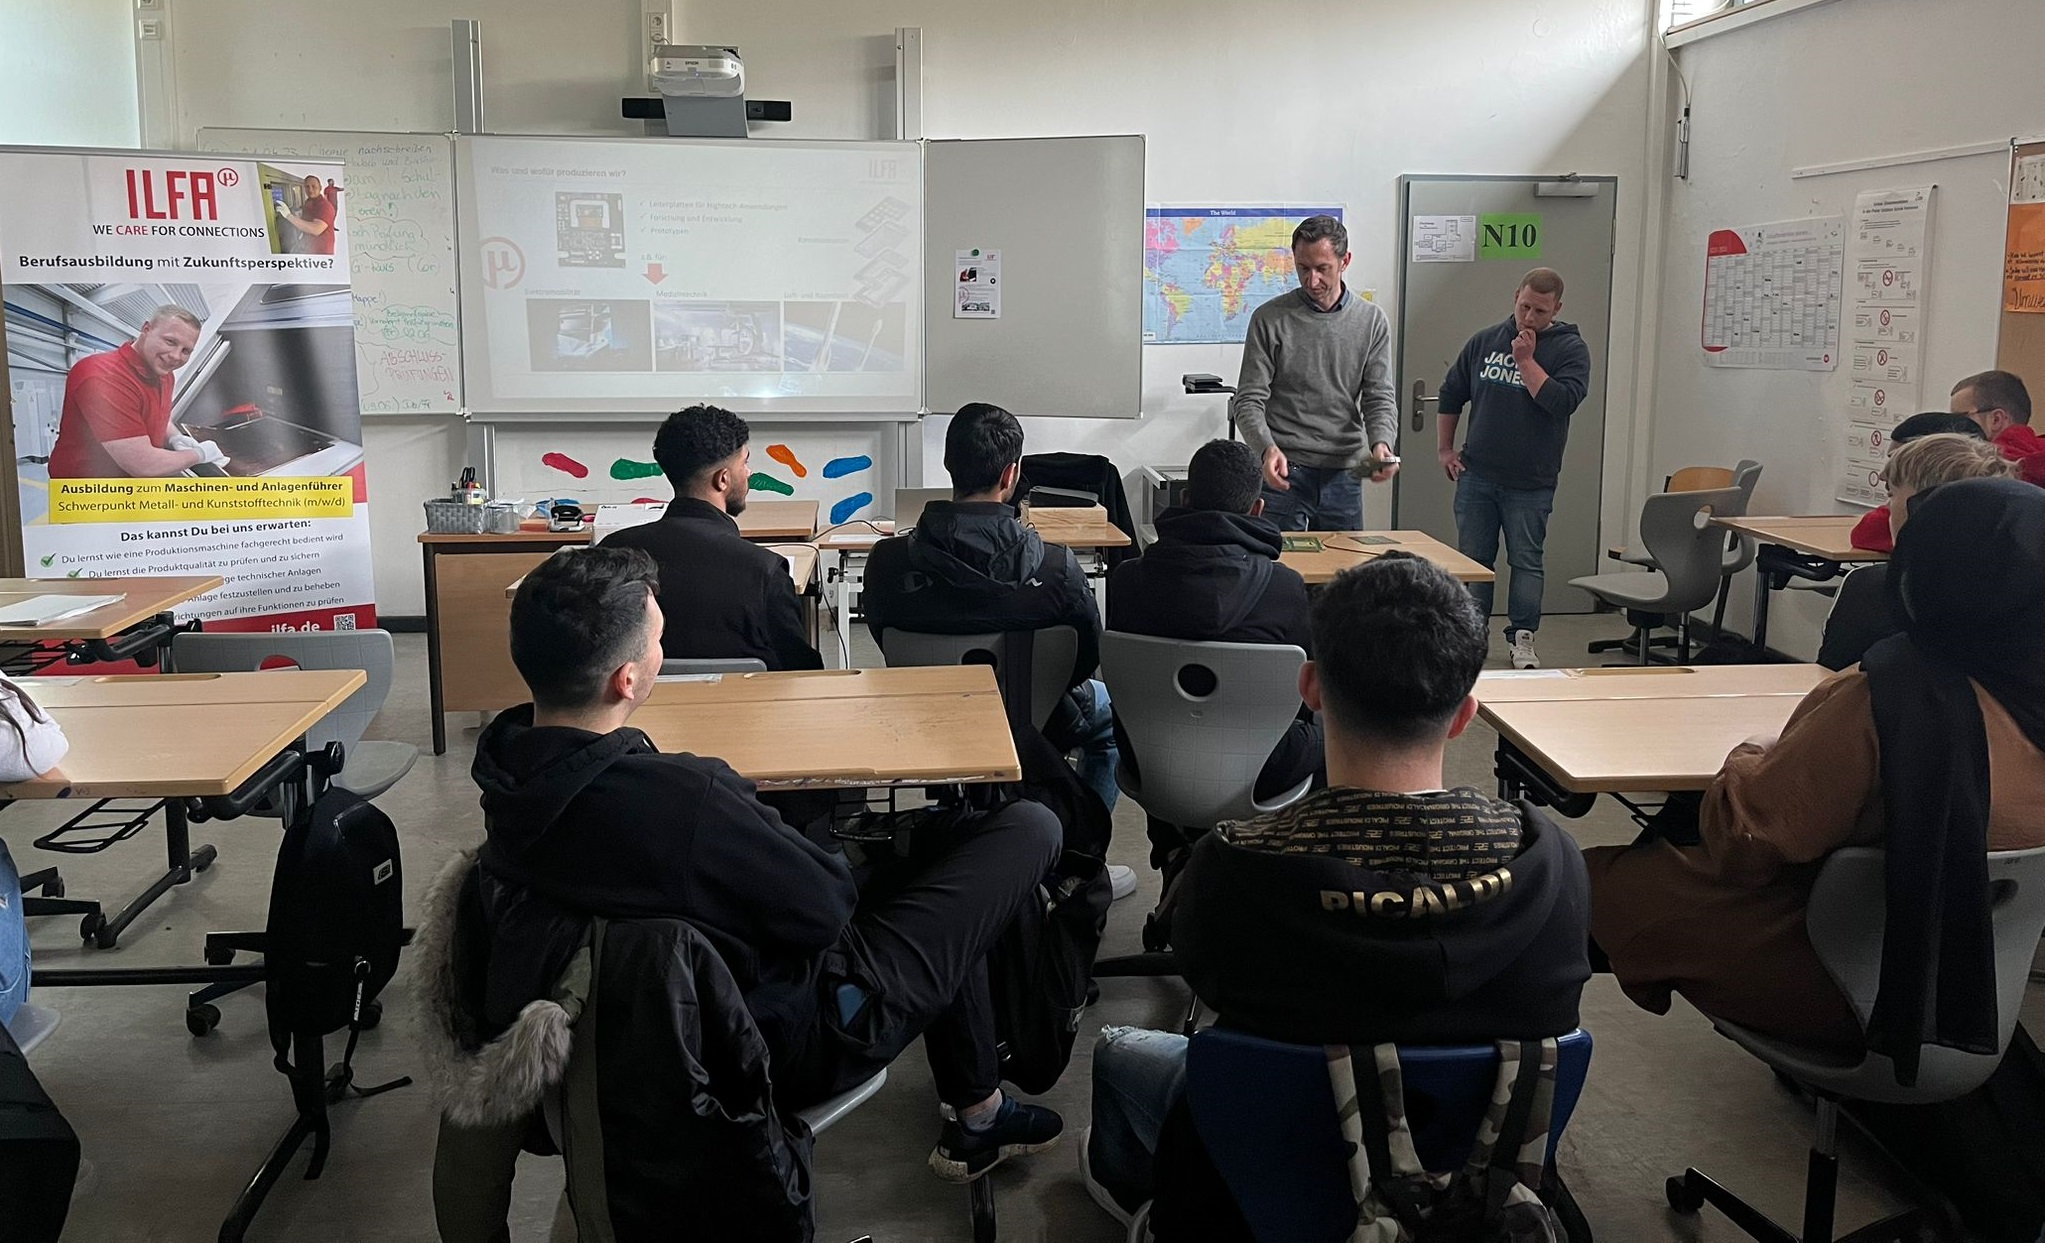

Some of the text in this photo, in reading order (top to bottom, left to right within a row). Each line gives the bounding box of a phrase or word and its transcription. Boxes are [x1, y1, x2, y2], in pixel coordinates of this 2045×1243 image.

[556, 168, 606, 178] produzieren
[609, 169, 627, 178] wir?
[126, 169, 218, 221] ILFA
[93, 225, 265, 238] WE CARE FOR CONNECTIONS
[1482, 223, 1537, 248] N10
[19, 255, 334, 271] Berufsausbildung mit Zukunftsperspektive?
[1484, 351, 1519, 369] JAC
[61, 482, 343, 495] Ausbildung zum Maschinen- und Anlagenführer
[58, 497, 345, 512] Schwerpunkt Metall- und Kunststofftechnik (m/w/d)
[121, 519, 311, 541] Das kannst Du bei uns erwarten:
[62, 533, 344, 563] Du lernst wie eine Produktionsmaschine fachgerecht bedient wird
[88, 570, 102, 578] Du
[104, 567, 130, 577] lernst
[132, 566, 147, 575] die
[148, 559, 217, 573] Produktqualität
[230, 557, 259, 569] prüfen
[260, 554, 277, 563] und
[290, 551, 320, 561] sichern
[224, 567, 322, 584] ge technischer Anlagen
[220, 588, 273, 599] festzustellen
[275, 584, 291, 594] und
[304, 581, 341, 591] beheben
[174, 609, 222, 620] richtungen
[224, 605, 239, 615] auf
[240, 603, 257, 613] ihre
[258, 600, 305, 612] Funktionen
[318, 596, 345, 607] prüfen
